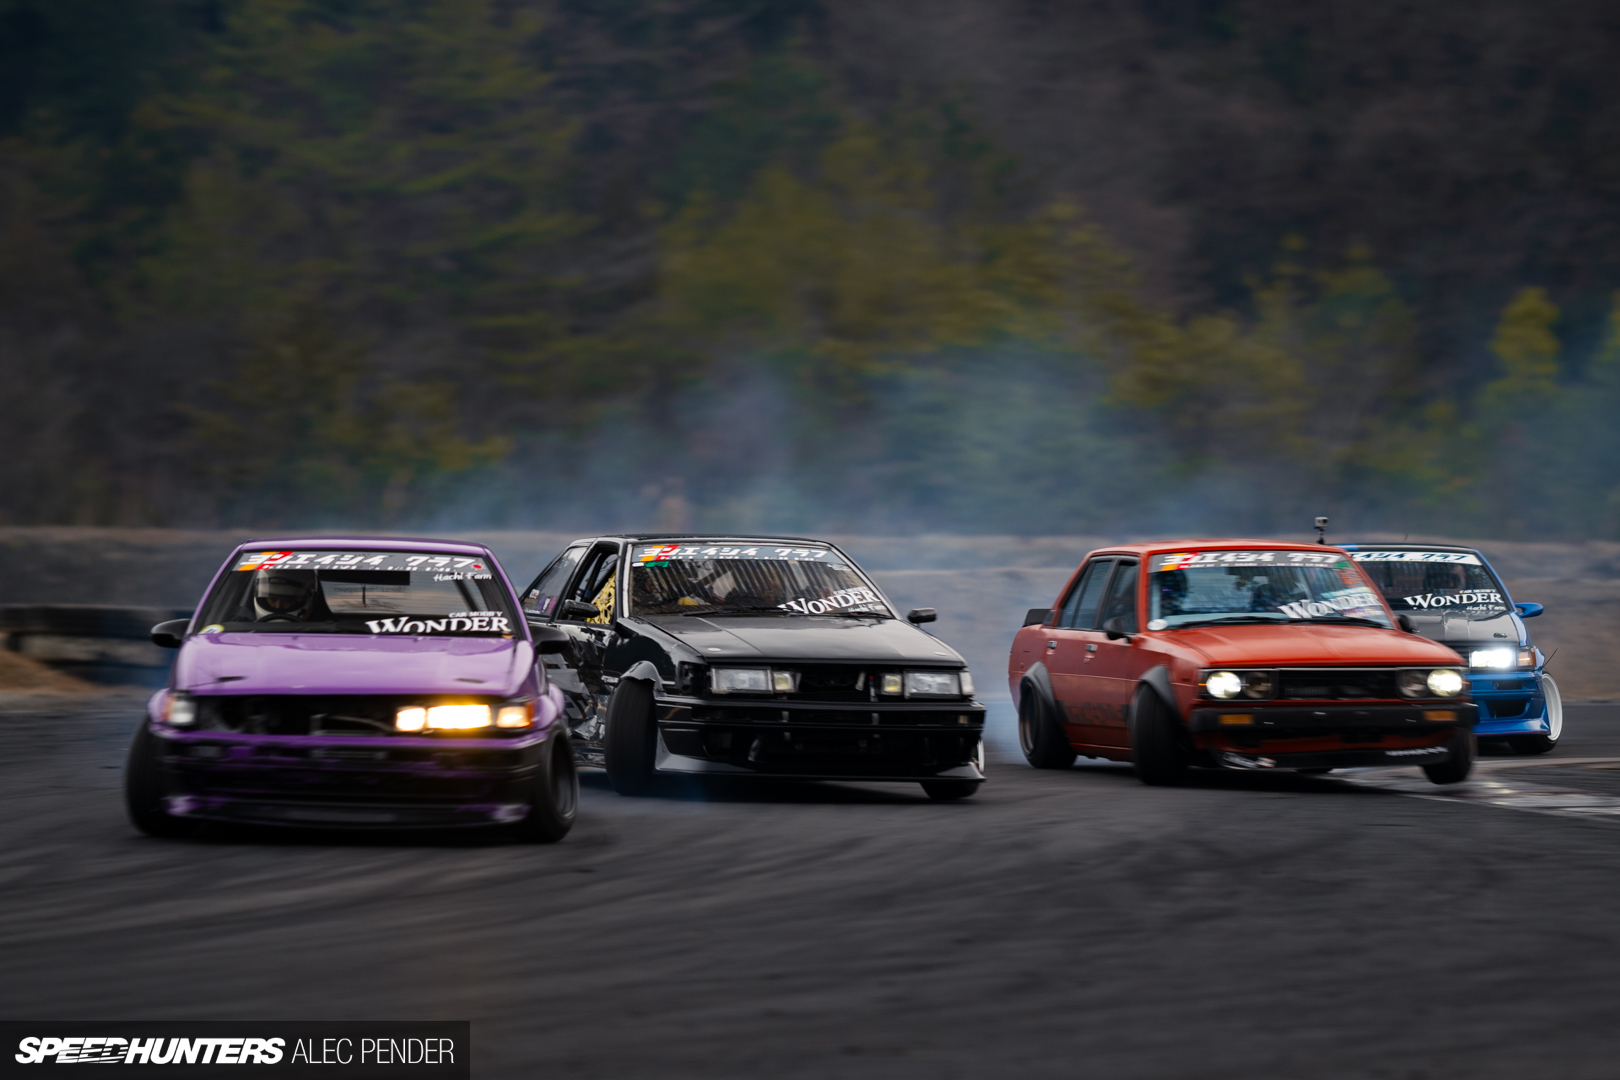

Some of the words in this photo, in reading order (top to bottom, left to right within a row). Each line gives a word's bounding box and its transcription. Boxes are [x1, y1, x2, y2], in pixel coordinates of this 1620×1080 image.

[433, 571, 464, 582] Hachi
[776, 590, 881, 614] WONDER
[1277, 593, 1383, 619] WONDER
[1403, 592, 1504, 609] WONDER
[365, 616, 512, 634] WONDER
